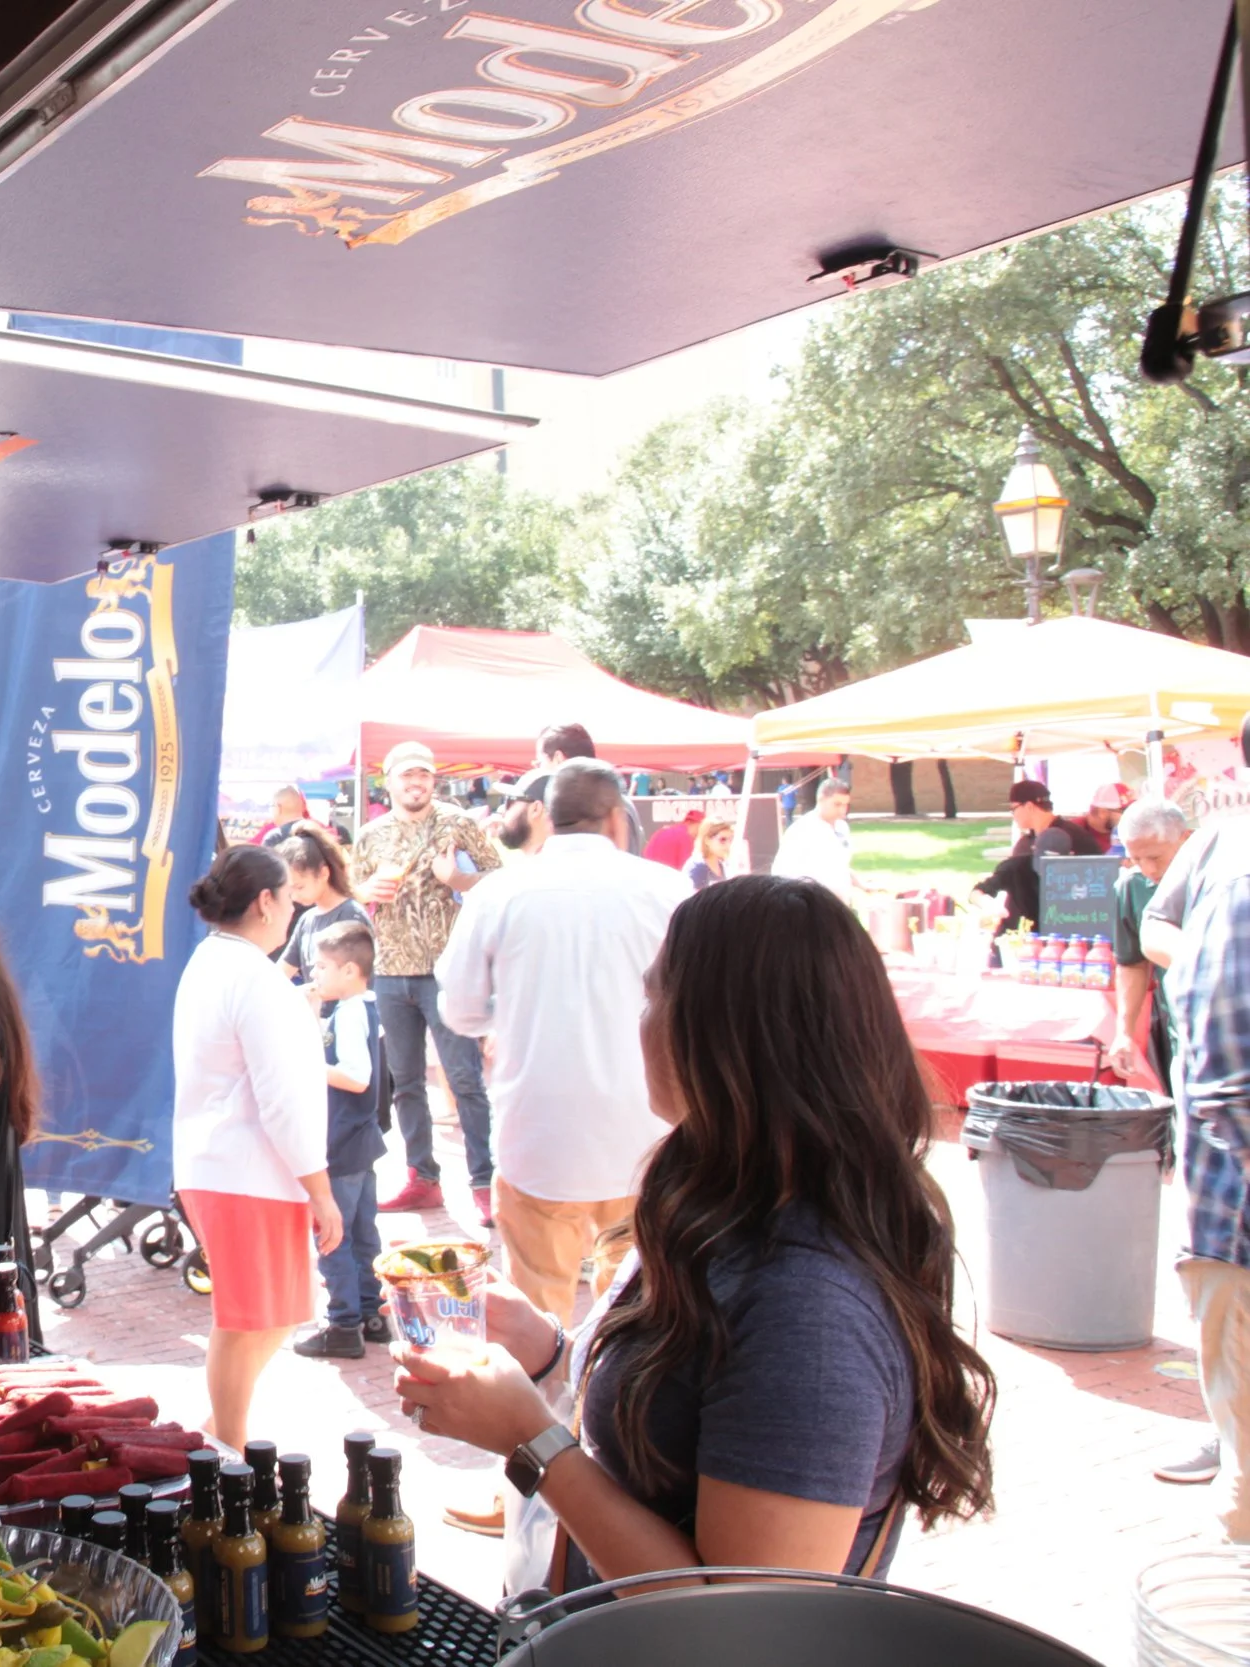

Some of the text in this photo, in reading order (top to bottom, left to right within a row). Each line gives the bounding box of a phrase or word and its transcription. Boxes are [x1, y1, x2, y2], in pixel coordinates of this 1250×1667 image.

[309, 0, 474, 98] CERVEZ
[658, 76, 753, 117] 1925
[27, 705, 56, 814] CERVEZA
[42, 609, 145, 912] Modelo
[159, 741, 174, 783] 1925
